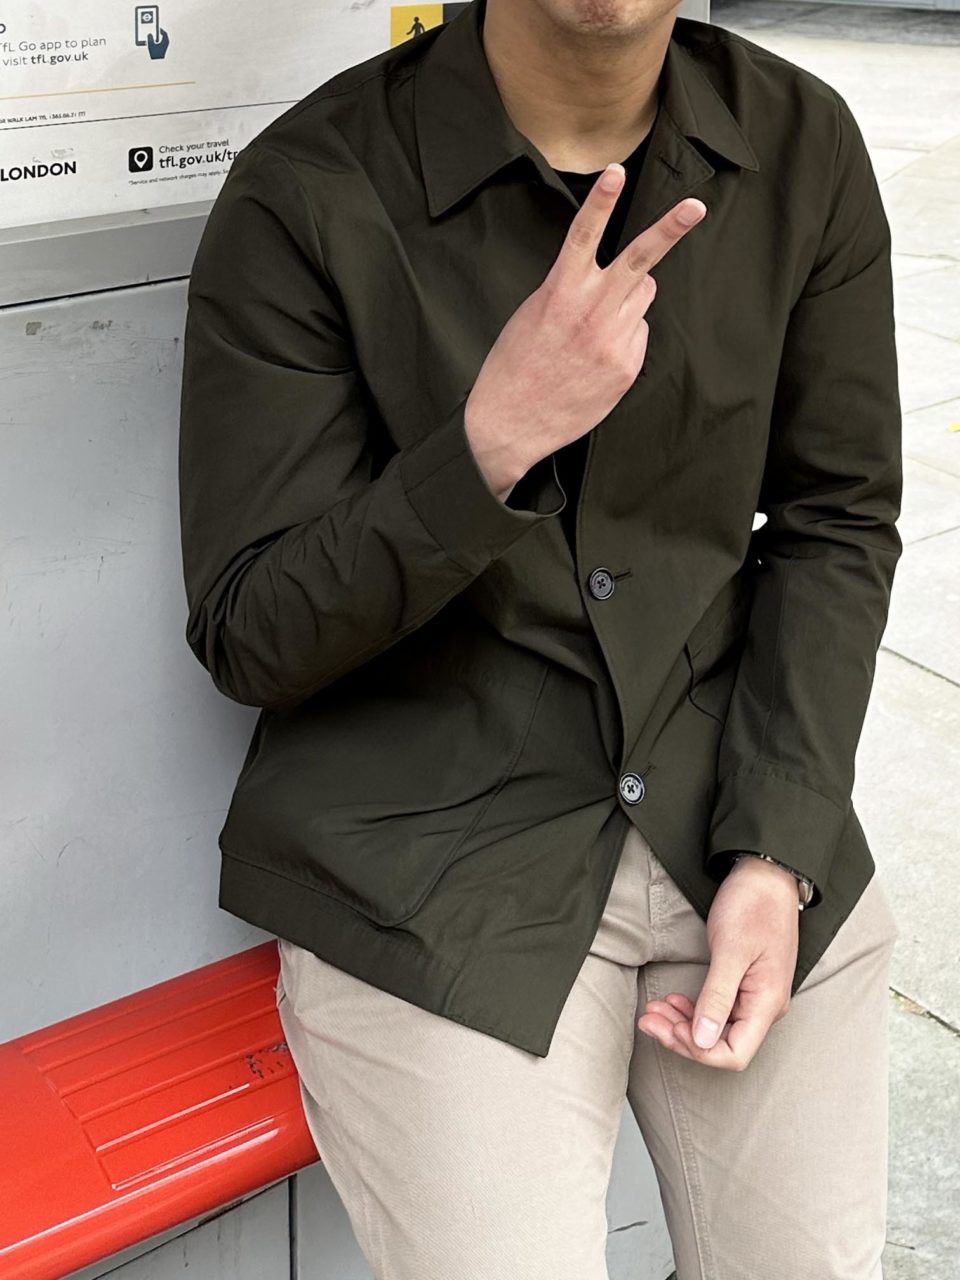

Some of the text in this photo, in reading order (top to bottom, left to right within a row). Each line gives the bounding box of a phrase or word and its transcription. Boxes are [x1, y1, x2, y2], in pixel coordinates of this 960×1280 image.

[18, 41, 37, 51] Go
[40, 41, 62, 54] app
[65, 39, 78, 48] to
[81, 37, 107, 51] plan
[3, 51, 89, 66] visit tfl.gov.uk
[159, 138, 230, 154] Check your travel
[1, 161, 77, 182] LONDON
